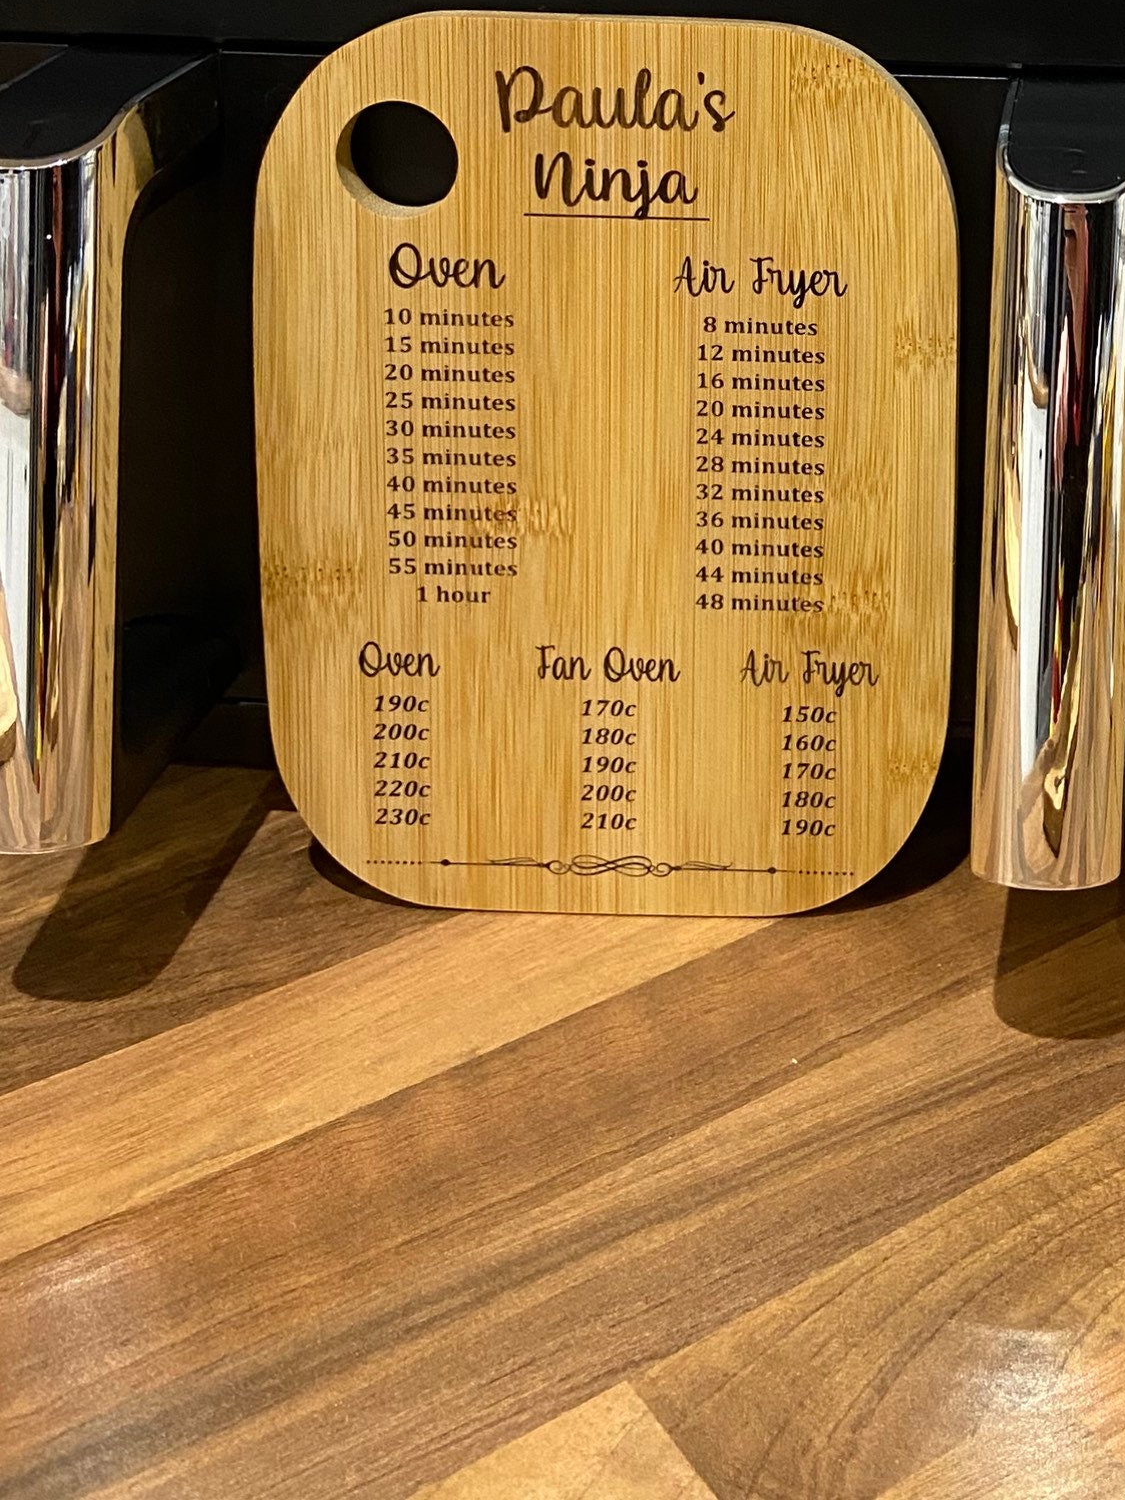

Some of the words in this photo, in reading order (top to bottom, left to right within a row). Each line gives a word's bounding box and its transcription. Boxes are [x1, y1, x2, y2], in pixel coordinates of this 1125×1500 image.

[494, 65, 736, 134] Paula's
[533, 151, 699, 219] Ninja
[387, 242, 507, 290] Oven
[672, 255, 736, 298] Air
[749, 256, 849, 310] Fryer
[383, 307, 413, 326] 10
[419, 311, 515, 328] minutes
[703, 316, 717, 333] 8
[724, 320, 818, 336] minutes
[384, 334, 413, 354] 15
[420, 339, 515, 357] minutes
[697, 343, 724, 362] 12
[731, 347, 826, 365] minutes
[384, 363, 413, 382] 20
[420, 367, 516, 384] minutes
[697, 371, 725, 390] 16
[731, 375, 825, 393] minutes
[385, 391, 414, 410] 25
[421, 395, 516, 412] minutes
[696, 399, 724, 418] 20
[731, 403, 825, 421] minutes
[385, 419, 414, 437] 30
[421, 423, 516, 440] minutes
[696, 427, 726, 445] 24
[731, 431, 825, 449] minutes
[386, 447, 415, 465] 35
[422, 451, 517, 468] minutes
[695, 455, 725, 473] 28
[731, 459, 825, 476] minutes
[386, 475, 416, 493] 40
[423, 478, 517, 495] minutes
[695, 483, 724, 501] 32
[731, 487, 825, 504] minutes
[386, 502, 416, 520] 45
[423, 505, 518, 523] minutes
[696, 510, 724, 528] 36
[731, 512, 824, 532] minutes
[388, 529, 417, 548] 50
[423, 533, 518, 550] minutes
[694, 538, 725, 556] 40
[731, 539, 825, 560] minutes
[388, 557, 417, 575] 55
[424, 561, 518, 577] minutes
[695, 565, 725, 583] 44
[731, 569, 824, 586] minutes
[415, 583, 428, 603] 1
[436, 585, 492, 604] hour
[695, 593, 724, 611] 48
[731, 596, 825, 614] minutes
[358, 640, 441, 678] Oven
[534, 644, 592, 681] Fan
[602, 645, 682, 684] Oven
[739, 648, 790, 688] Air
[800, 649, 880, 699] Fryer
[373, 694, 430, 713] 190c
[580, 699, 637, 718] 170c
[782, 705, 837, 724] 150c
[372, 722, 431, 741] 200c
[581, 727, 637, 746] 180c
[781, 733, 837, 752] 160c
[373, 751, 431, 770] 210c
[581, 755, 637, 774] 190c
[782, 762, 837, 781] 170c
[373, 779, 432, 798] 220c
[580, 784, 637, 803] 200c
[782, 790, 837, 809] 180c
[374, 807, 432, 827] 230c
[579, 812, 637, 831] 210c
[781, 818, 836, 837] 190c
